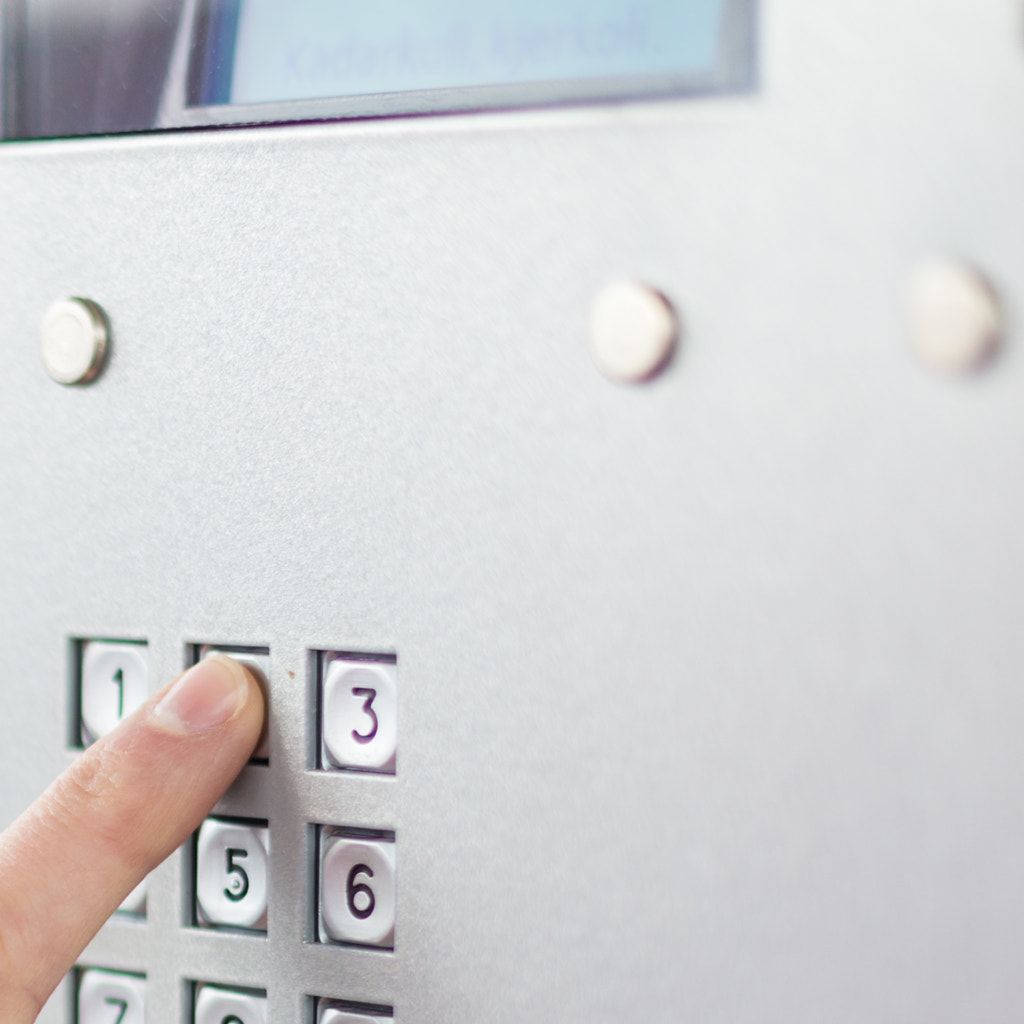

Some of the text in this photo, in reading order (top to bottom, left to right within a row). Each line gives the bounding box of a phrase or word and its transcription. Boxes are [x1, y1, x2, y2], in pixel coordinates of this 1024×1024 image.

[111, 667, 125, 720] 1
[350, 686, 379, 745] 3
[222, 846, 251, 903] 5
[345, 862, 377, 920] 6
